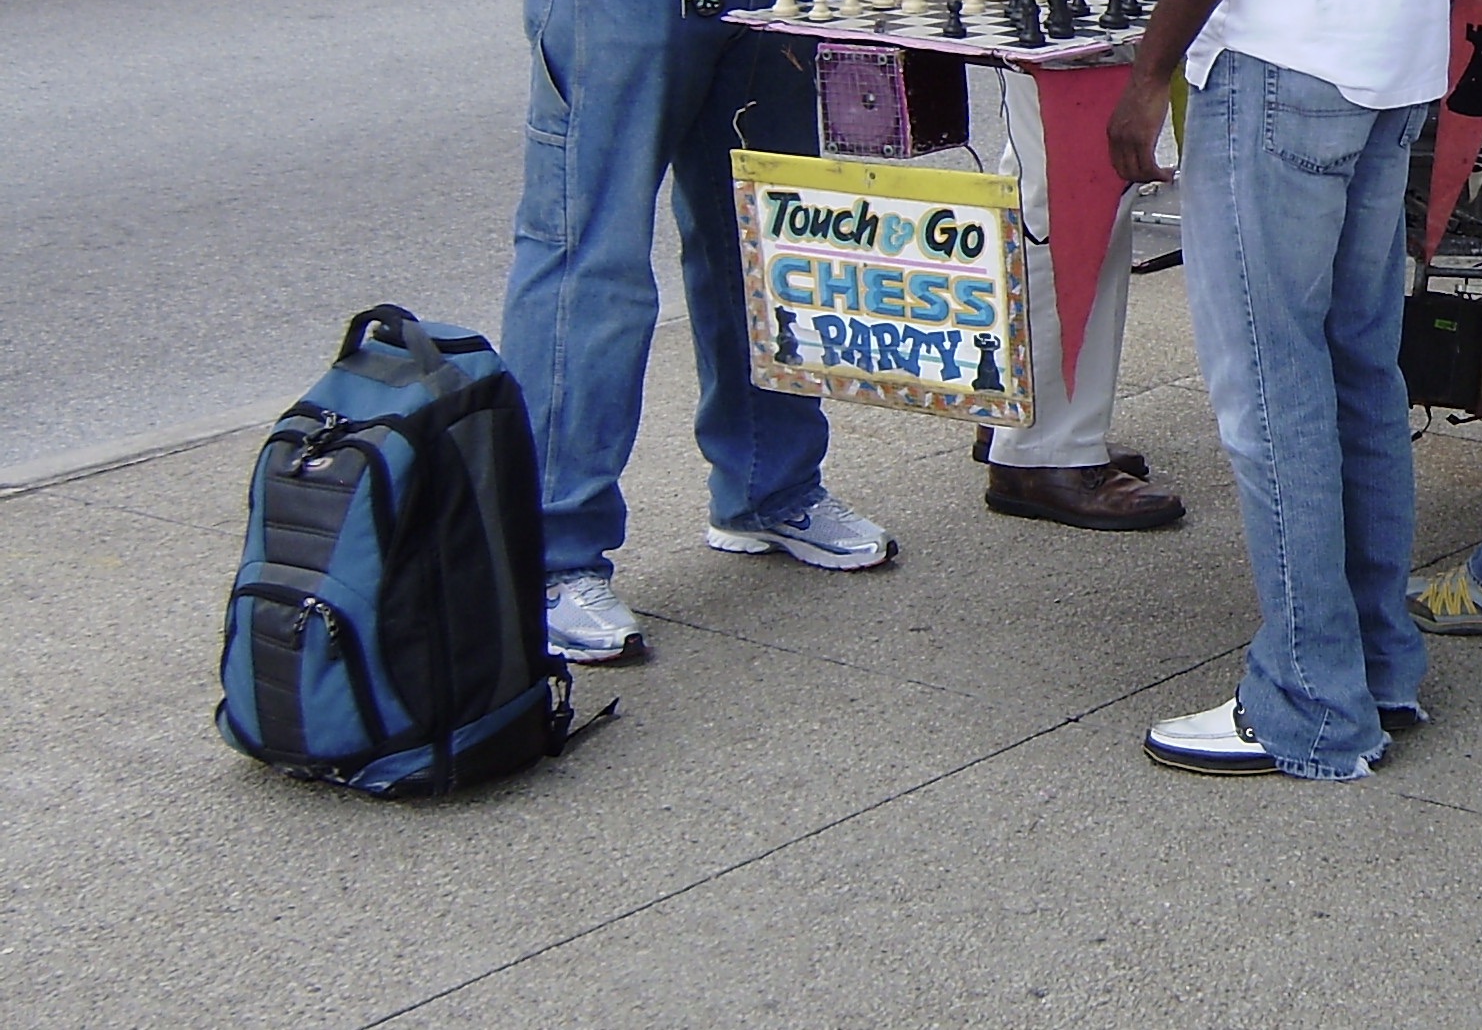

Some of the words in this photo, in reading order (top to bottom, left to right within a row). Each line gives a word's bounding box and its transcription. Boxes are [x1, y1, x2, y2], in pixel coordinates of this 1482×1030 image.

[765, 190, 879, 248] Touch
[880, 213, 914, 255] &
[923, 208, 985, 259] Go
[767, 254, 997, 329] CHESS
[811, 314, 963, 381] PARTY
